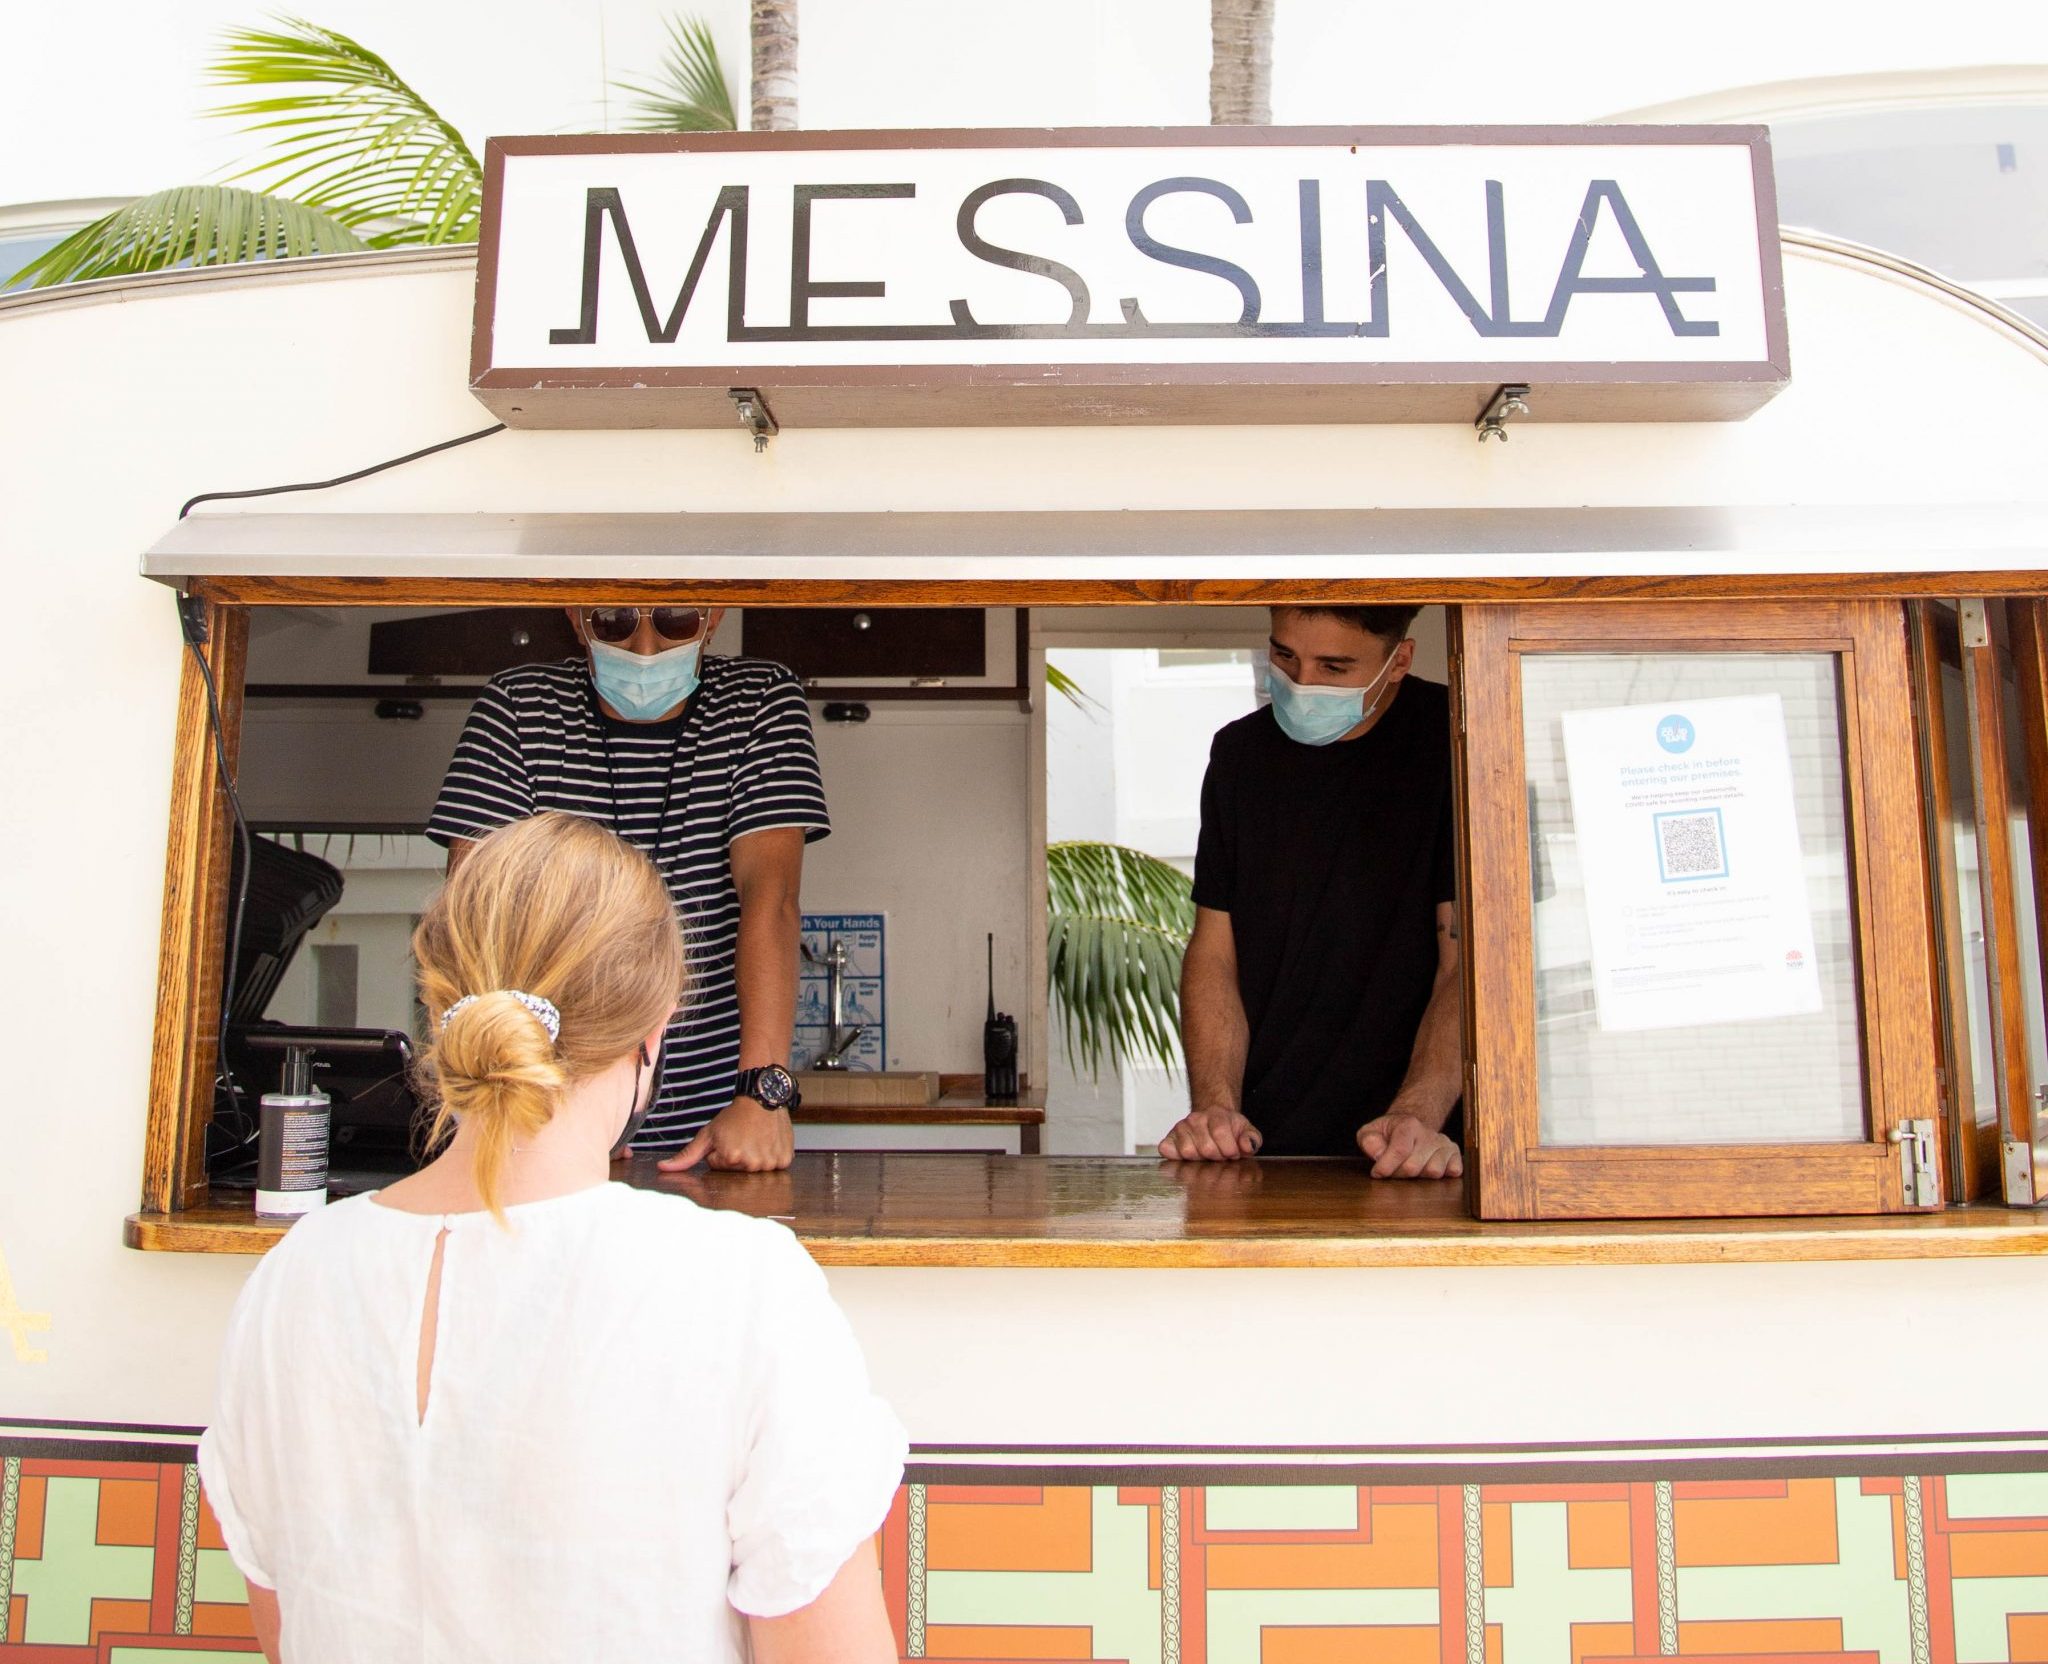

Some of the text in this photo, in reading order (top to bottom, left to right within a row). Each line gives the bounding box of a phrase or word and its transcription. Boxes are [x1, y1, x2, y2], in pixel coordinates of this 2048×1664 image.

[550, 178, 1719, 344] MESSINA
[1620, 757, 1740, 776] Please check in before
[1621, 769, 1743, 788] entering our premises.
[1650, 791, 1674, 801] helping
[1674, 790, 1690, 798] keep
[1703, 786, 1737, 795] community
[1625, 801, 1645, 809] COVID
[813, 918, 841, 929] Your
[842, 917, 880, 929] Hands
[859, 933, 878, 941] Apply
